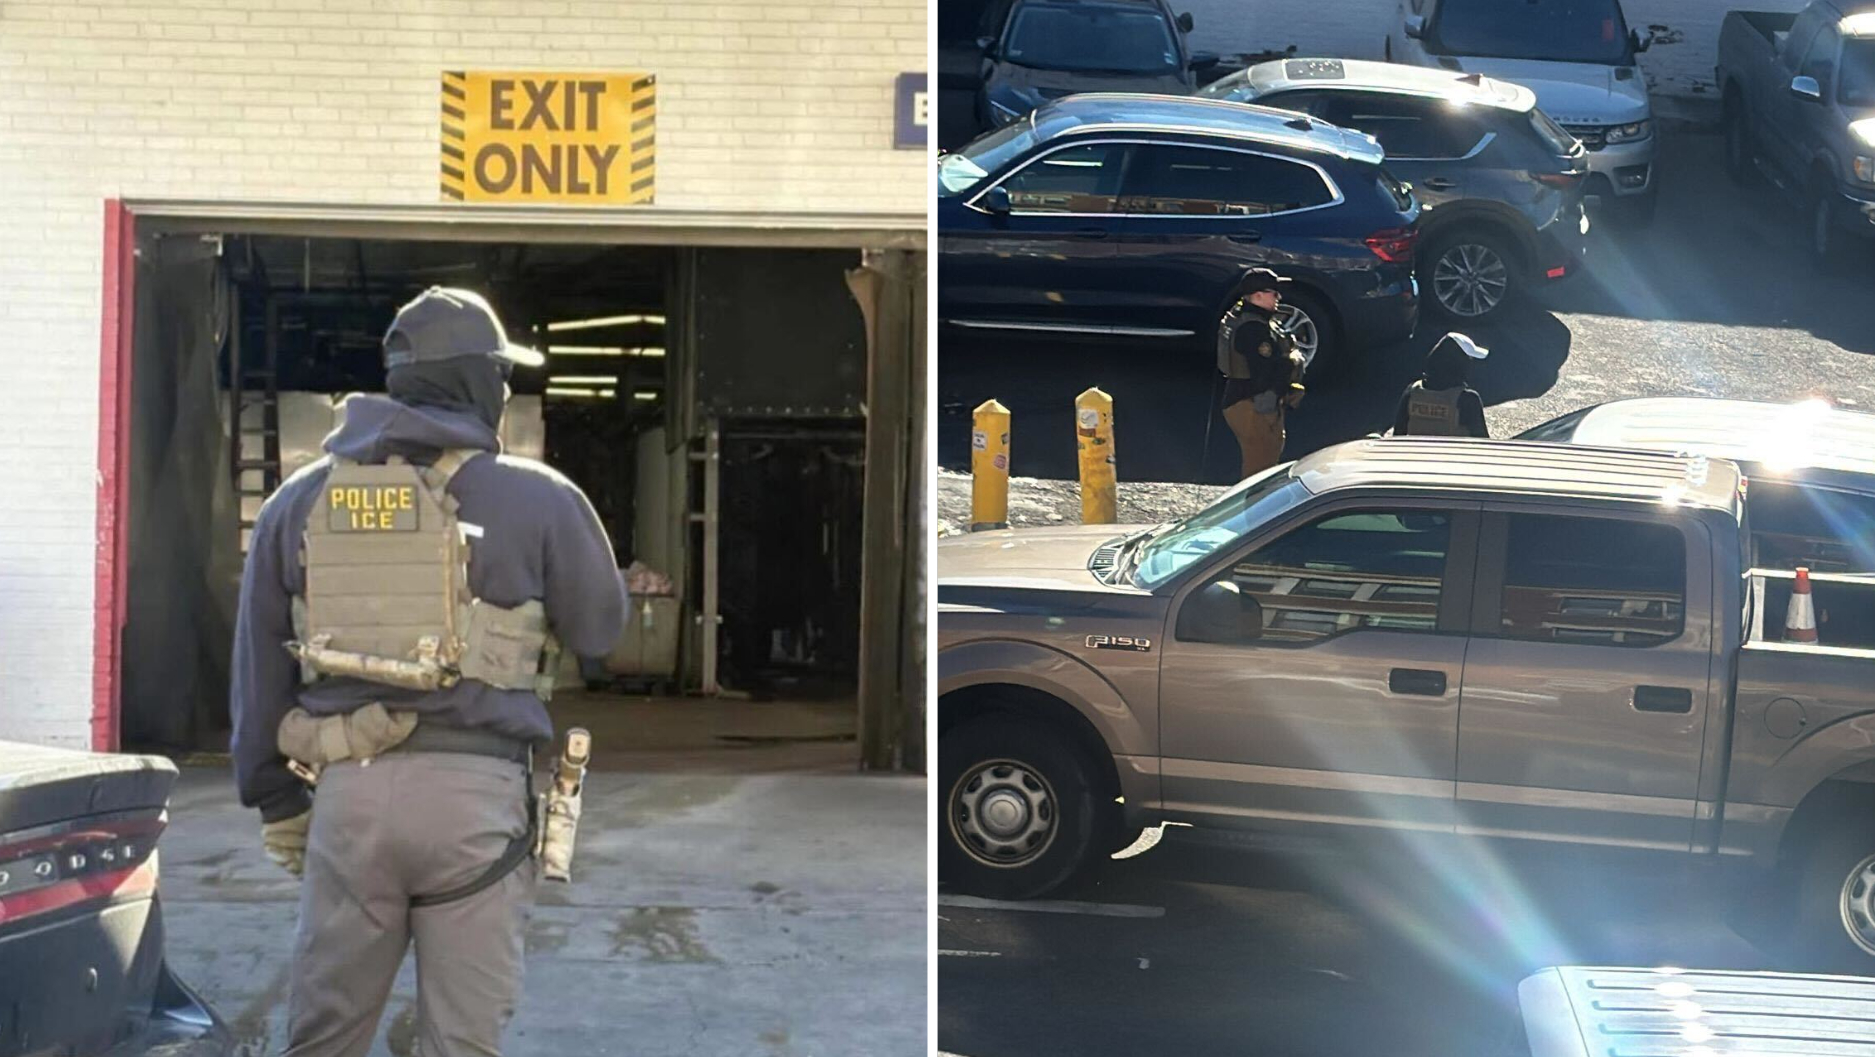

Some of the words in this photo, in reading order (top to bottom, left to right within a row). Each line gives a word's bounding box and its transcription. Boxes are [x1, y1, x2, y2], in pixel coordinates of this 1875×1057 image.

[490, 80, 606, 131] EXIT
[473, 143, 621, 195] ONLY
[332, 488, 412, 509] POLICE
[351, 511, 393, 529] ICE
